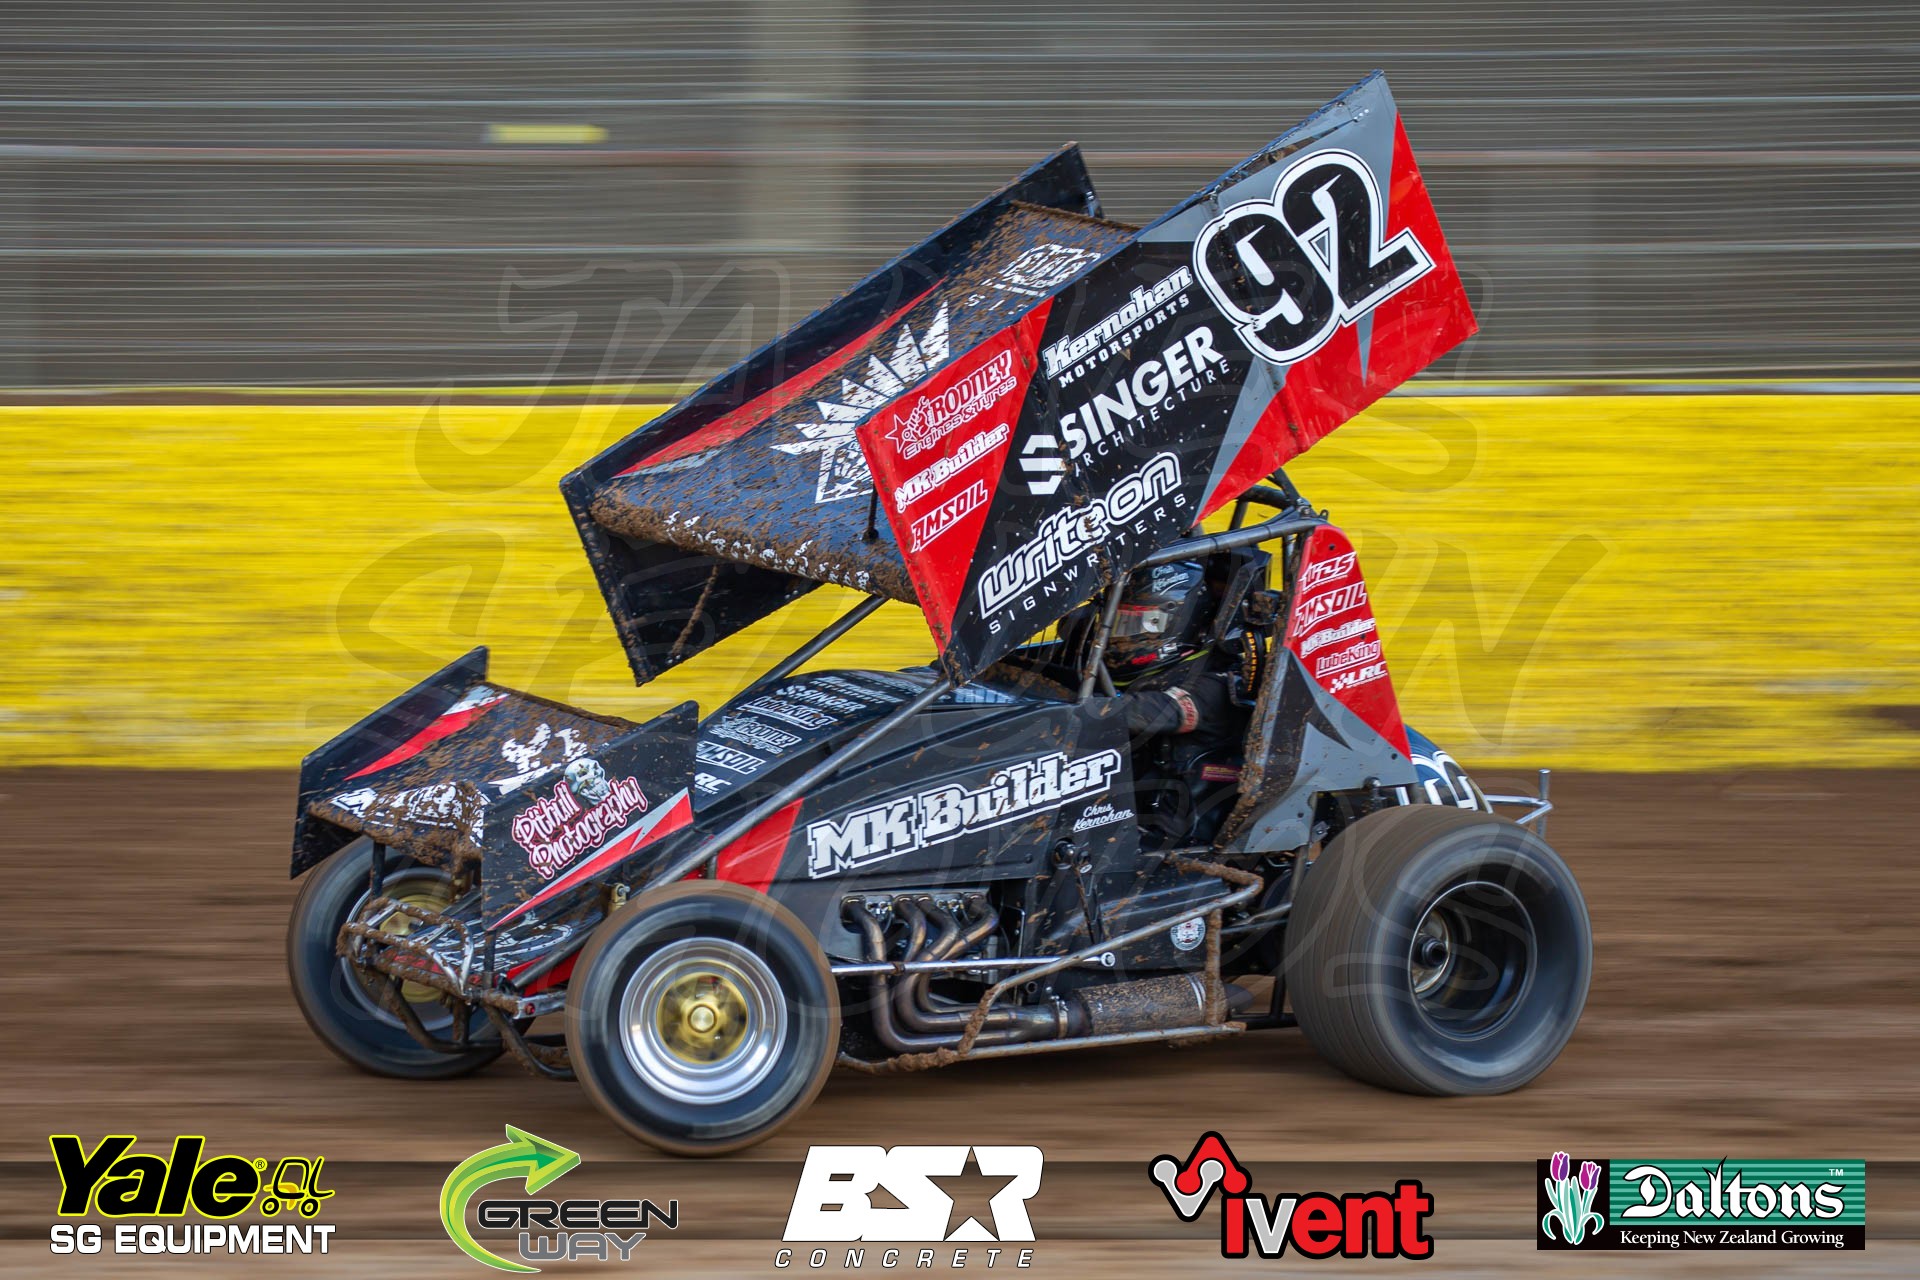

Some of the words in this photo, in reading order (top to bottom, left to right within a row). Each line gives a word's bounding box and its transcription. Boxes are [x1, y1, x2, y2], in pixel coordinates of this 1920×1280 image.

[1192, 148, 1437, 367] 92
[1042, 265, 1194, 380] Kernohan
[1058, 293, 1191, 389] MOTORSPORTS
[930, 349, 1012, 426] RODNEY
[1060, 325, 1224, 461] SINGER
[1074, 362, 1230, 478] ARCHITECTURE
[894, 467, 935, 514] MK
[930, 423, 1010, 487] Builder
[910, 479, 988, 554] AMSOIL
[1293, 580, 1367, 637] AMSOIL
[512, 781, 582, 846] Pitbull
[529, 776, 649, 880] Photography
[807, 794, 918, 880] MK
[916, 748, 1122, 848] Builder
[1072, 809, 1135, 833] Kernohan
[1082, 802, 1114, 818] Chris
